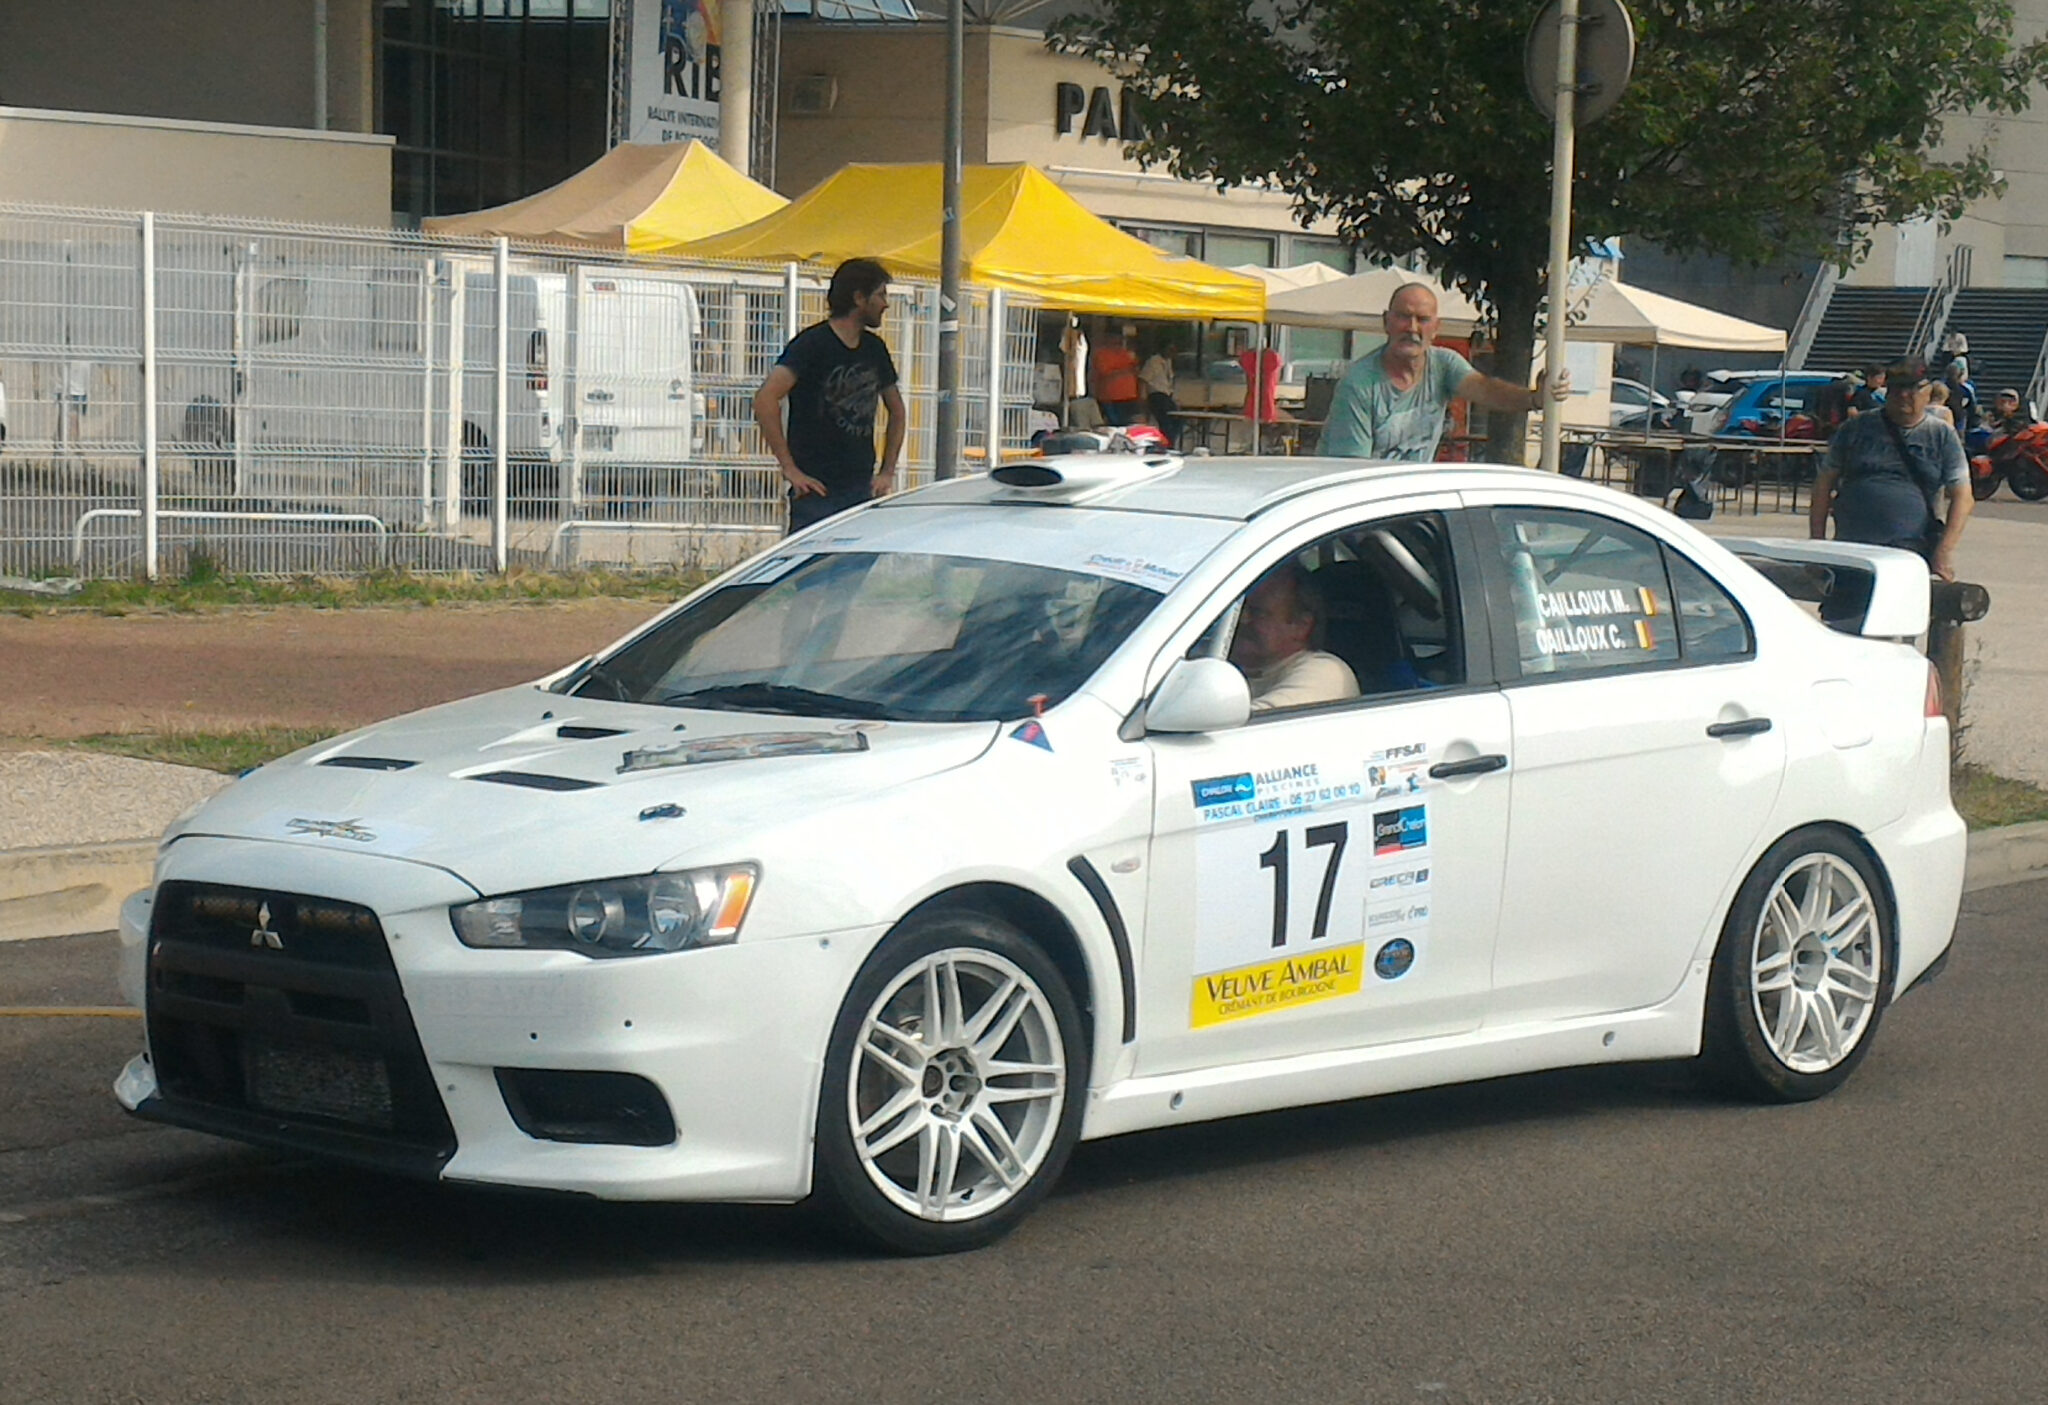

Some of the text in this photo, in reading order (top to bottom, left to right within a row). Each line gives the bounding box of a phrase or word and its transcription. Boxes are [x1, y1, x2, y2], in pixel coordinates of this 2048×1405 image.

[664, 36, 720, 102] RIB
[1537, 588, 1631, 617] CAILLOUX M.
[1535, 623, 1626, 654] CAILLOUX C.
[1386, 743, 1425, 759] FFSA
[1256, 763, 1318, 785] ALLIANCE
[1257, 778, 1320, 795] PISCINES
[1204, 805, 1243, 822] PASCAL
[1246, 797, 1281, 816] CLAIRE
[1259, 821, 1348, 948] 17
[1207, 954, 1353, 1002] VEUVE AMBAL
[1265, 994, 1276, 1004] DE
[1280, 979, 1336, 1002] BOURGOGNE
